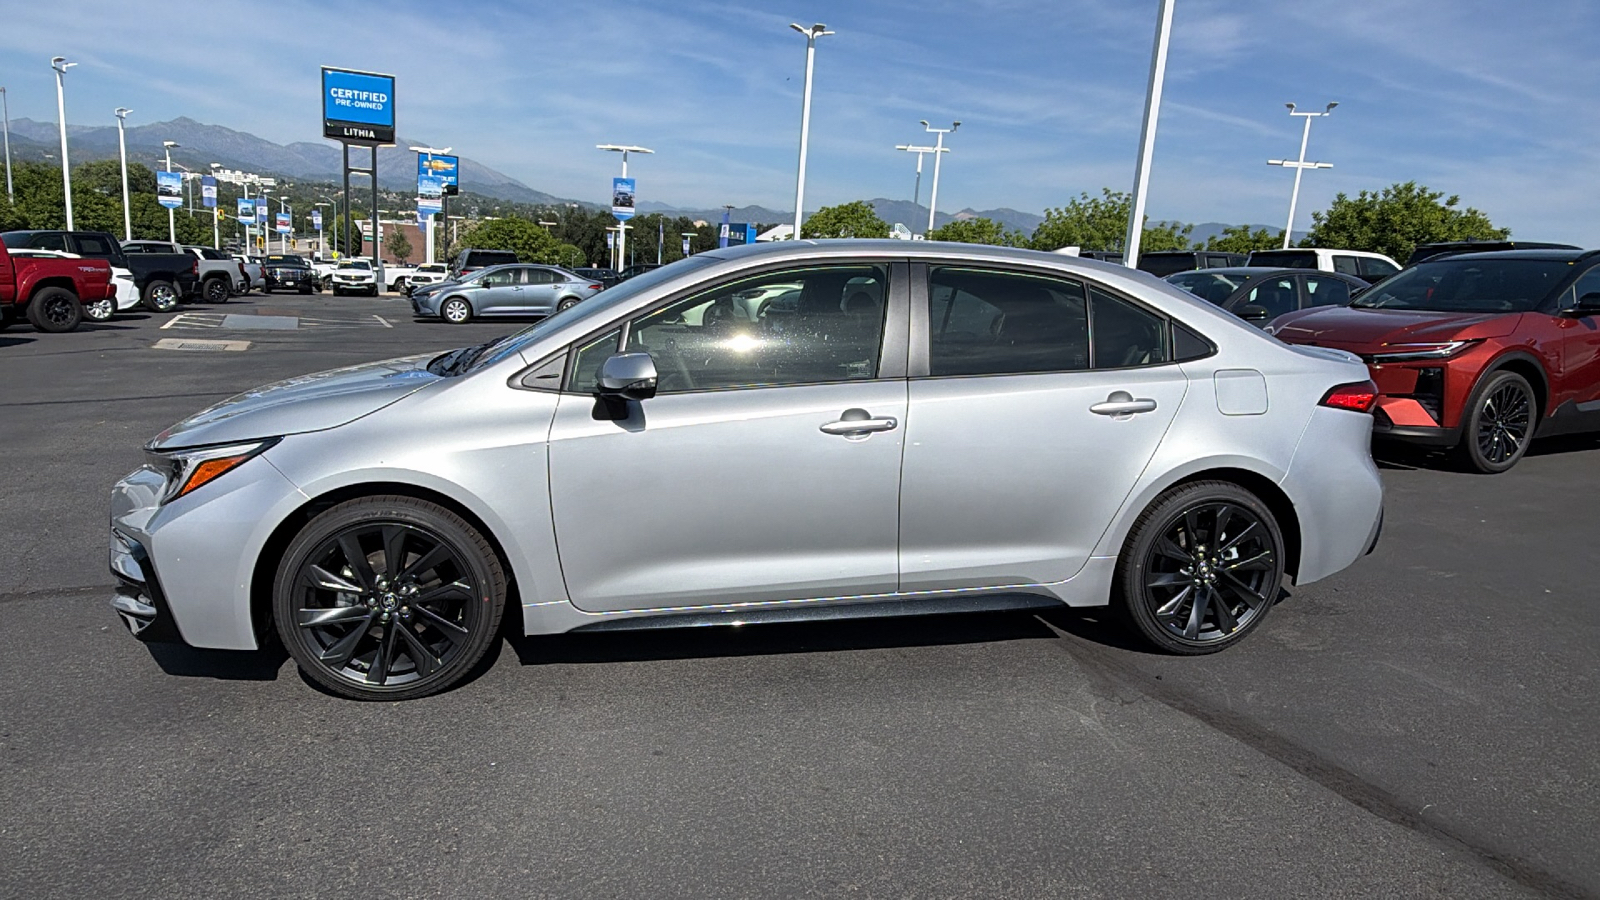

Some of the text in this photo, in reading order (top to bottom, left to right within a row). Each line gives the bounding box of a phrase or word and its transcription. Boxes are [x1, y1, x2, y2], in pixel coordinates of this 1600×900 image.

[330, 87, 388, 103] CERTIFIED
[335, 98, 383, 111] PRE-OWNED
[344, 128, 375, 138] LITHIA
